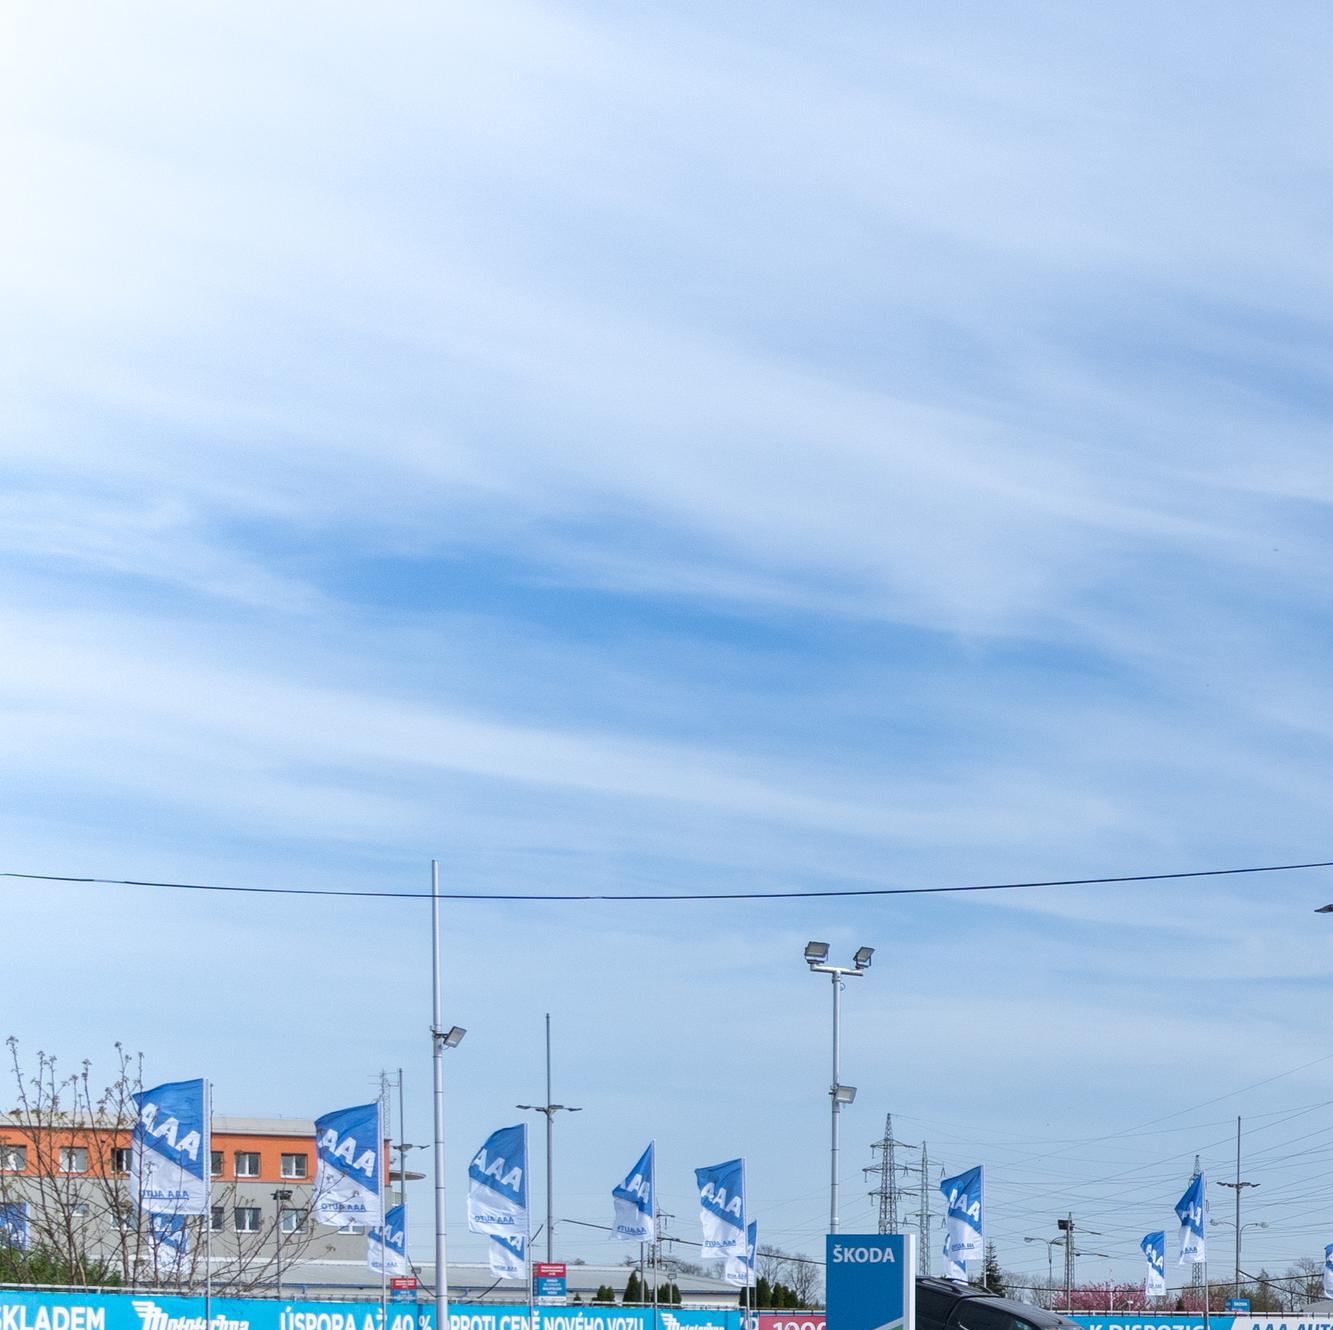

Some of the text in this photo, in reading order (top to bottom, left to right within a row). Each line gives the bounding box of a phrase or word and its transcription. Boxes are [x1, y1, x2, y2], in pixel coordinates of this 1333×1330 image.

[472, 1148, 523, 1192] AAA
[701, 1181, 742, 1218] AAA
[833, 1244, 895, 1263] ŠKODA
